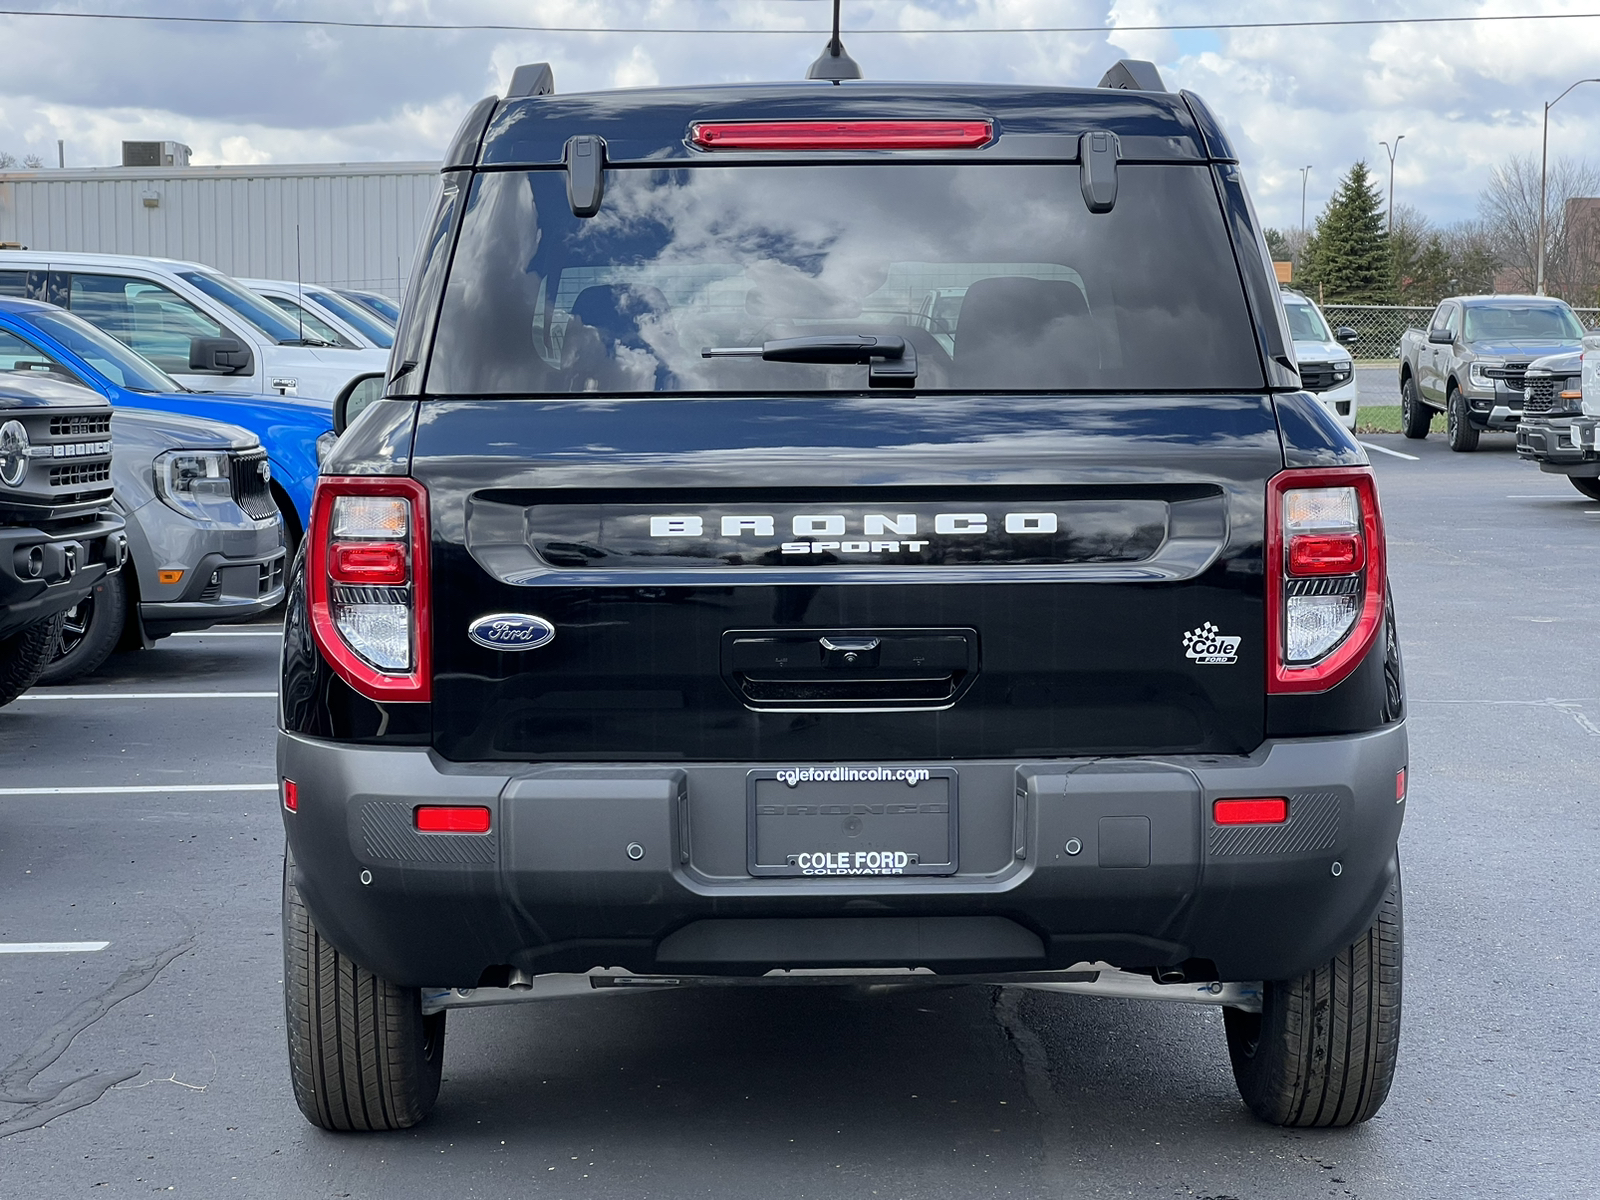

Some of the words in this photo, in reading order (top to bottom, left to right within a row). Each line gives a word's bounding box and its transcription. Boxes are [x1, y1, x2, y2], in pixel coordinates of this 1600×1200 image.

[53, 443, 111, 456] BRONCO
[650, 512, 1058, 537] BRONCO
[781, 540, 929, 554] SPORT
[488, 621, 534, 641] Ford
[1192, 639, 1235, 654] Cole
[776, 767, 930, 782] colefordlincoln.com
[756, 803, 949, 815] BRONCO
[798, 852, 850, 869] COLE
[855, 851, 908, 868] FORD
